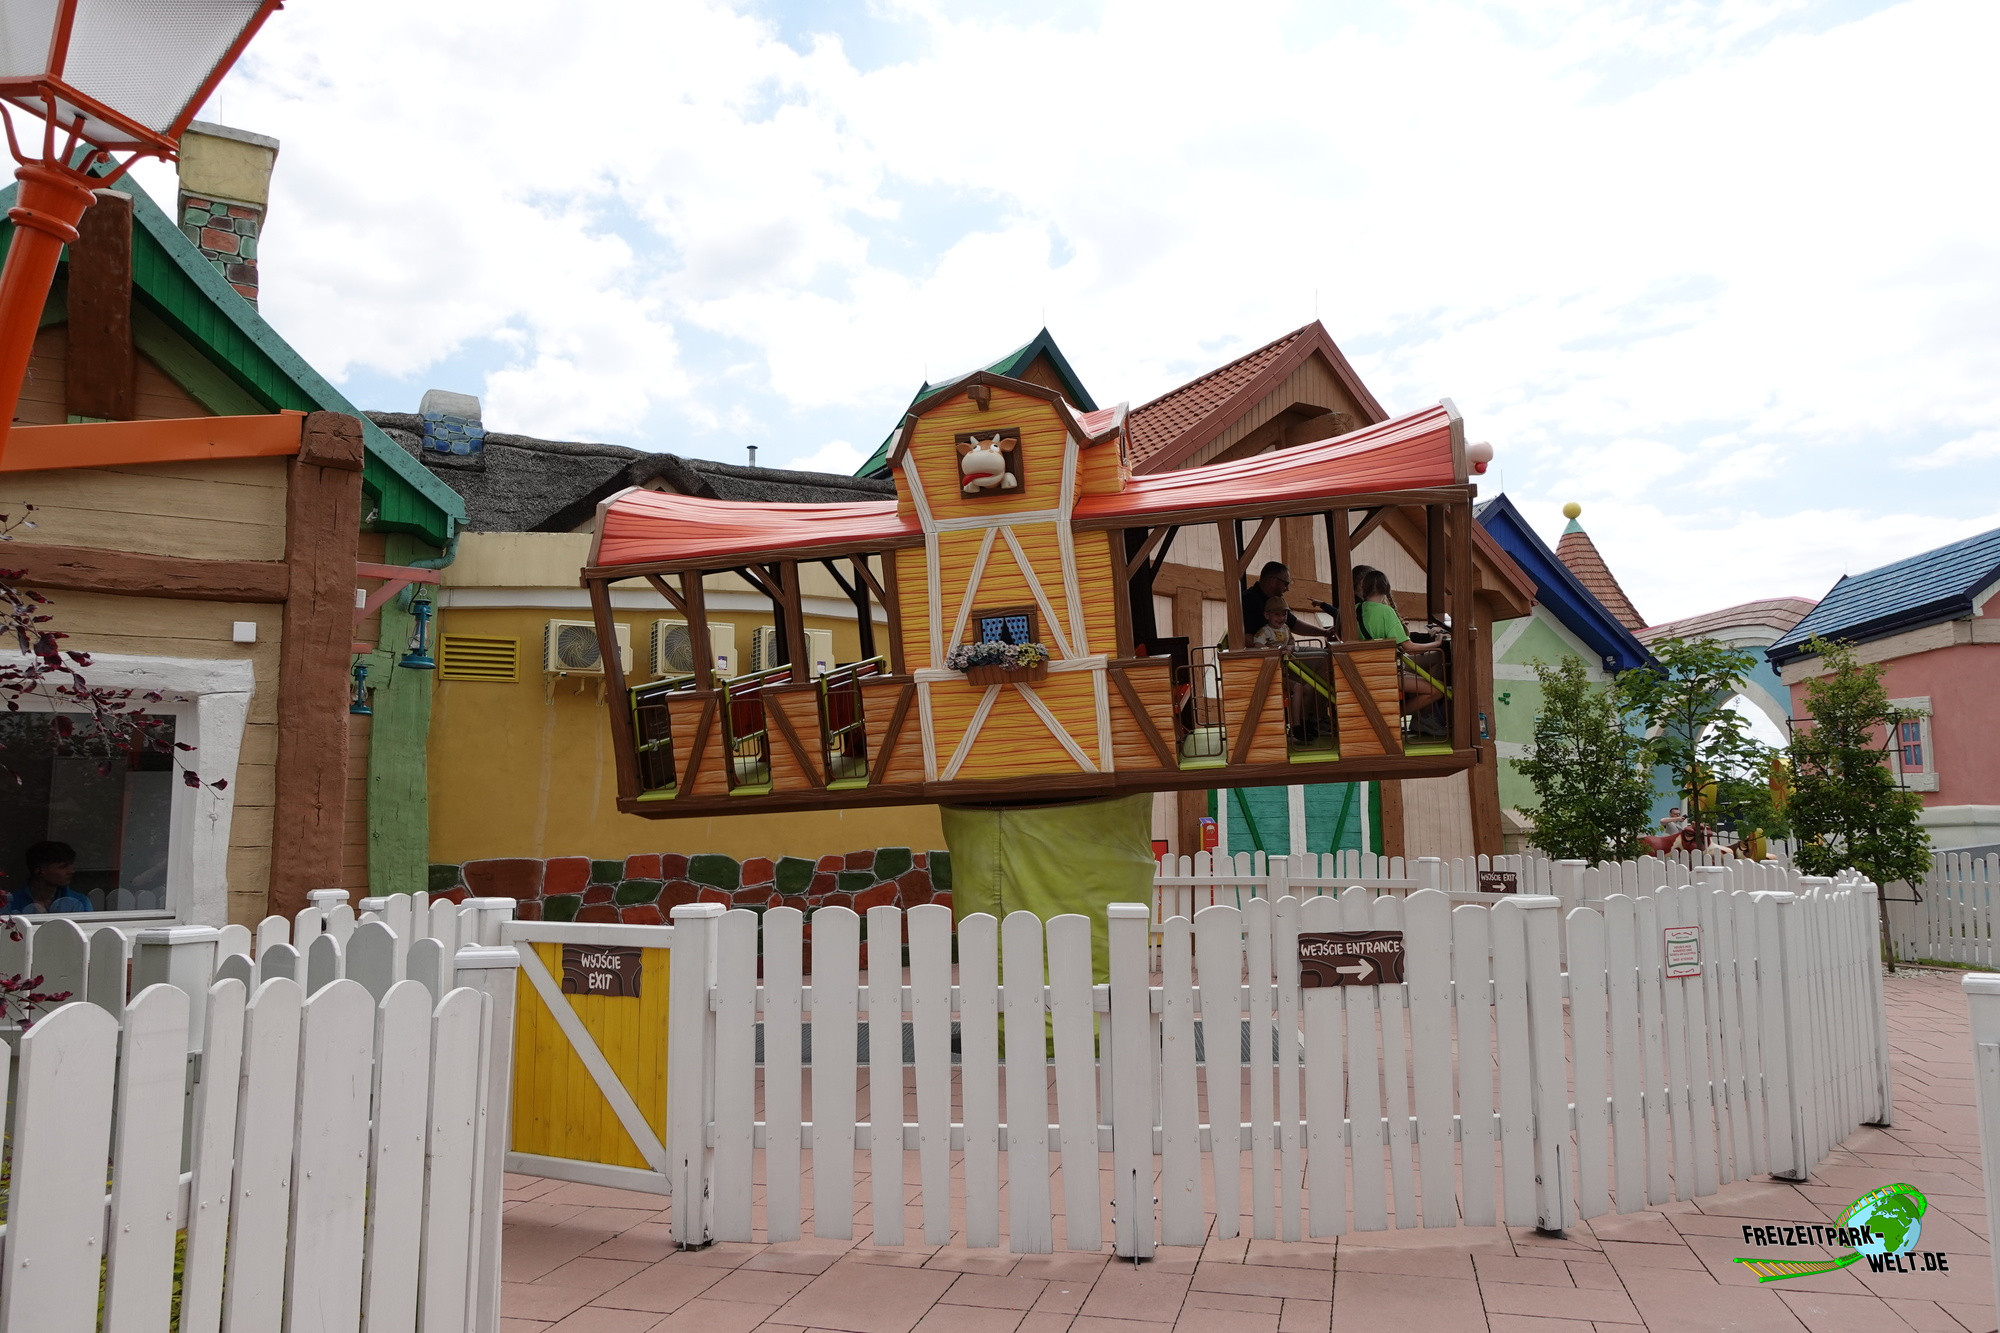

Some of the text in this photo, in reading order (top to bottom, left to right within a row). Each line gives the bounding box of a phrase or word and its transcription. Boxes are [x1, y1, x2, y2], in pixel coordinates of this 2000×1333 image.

[1503, 873, 1515, 882] EXIT
[1300, 939, 1400, 957] WEJŚCIE ENTRANCE
[581, 950, 621, 970] WYJŚCIE
[588, 971, 613, 990] EXIT
